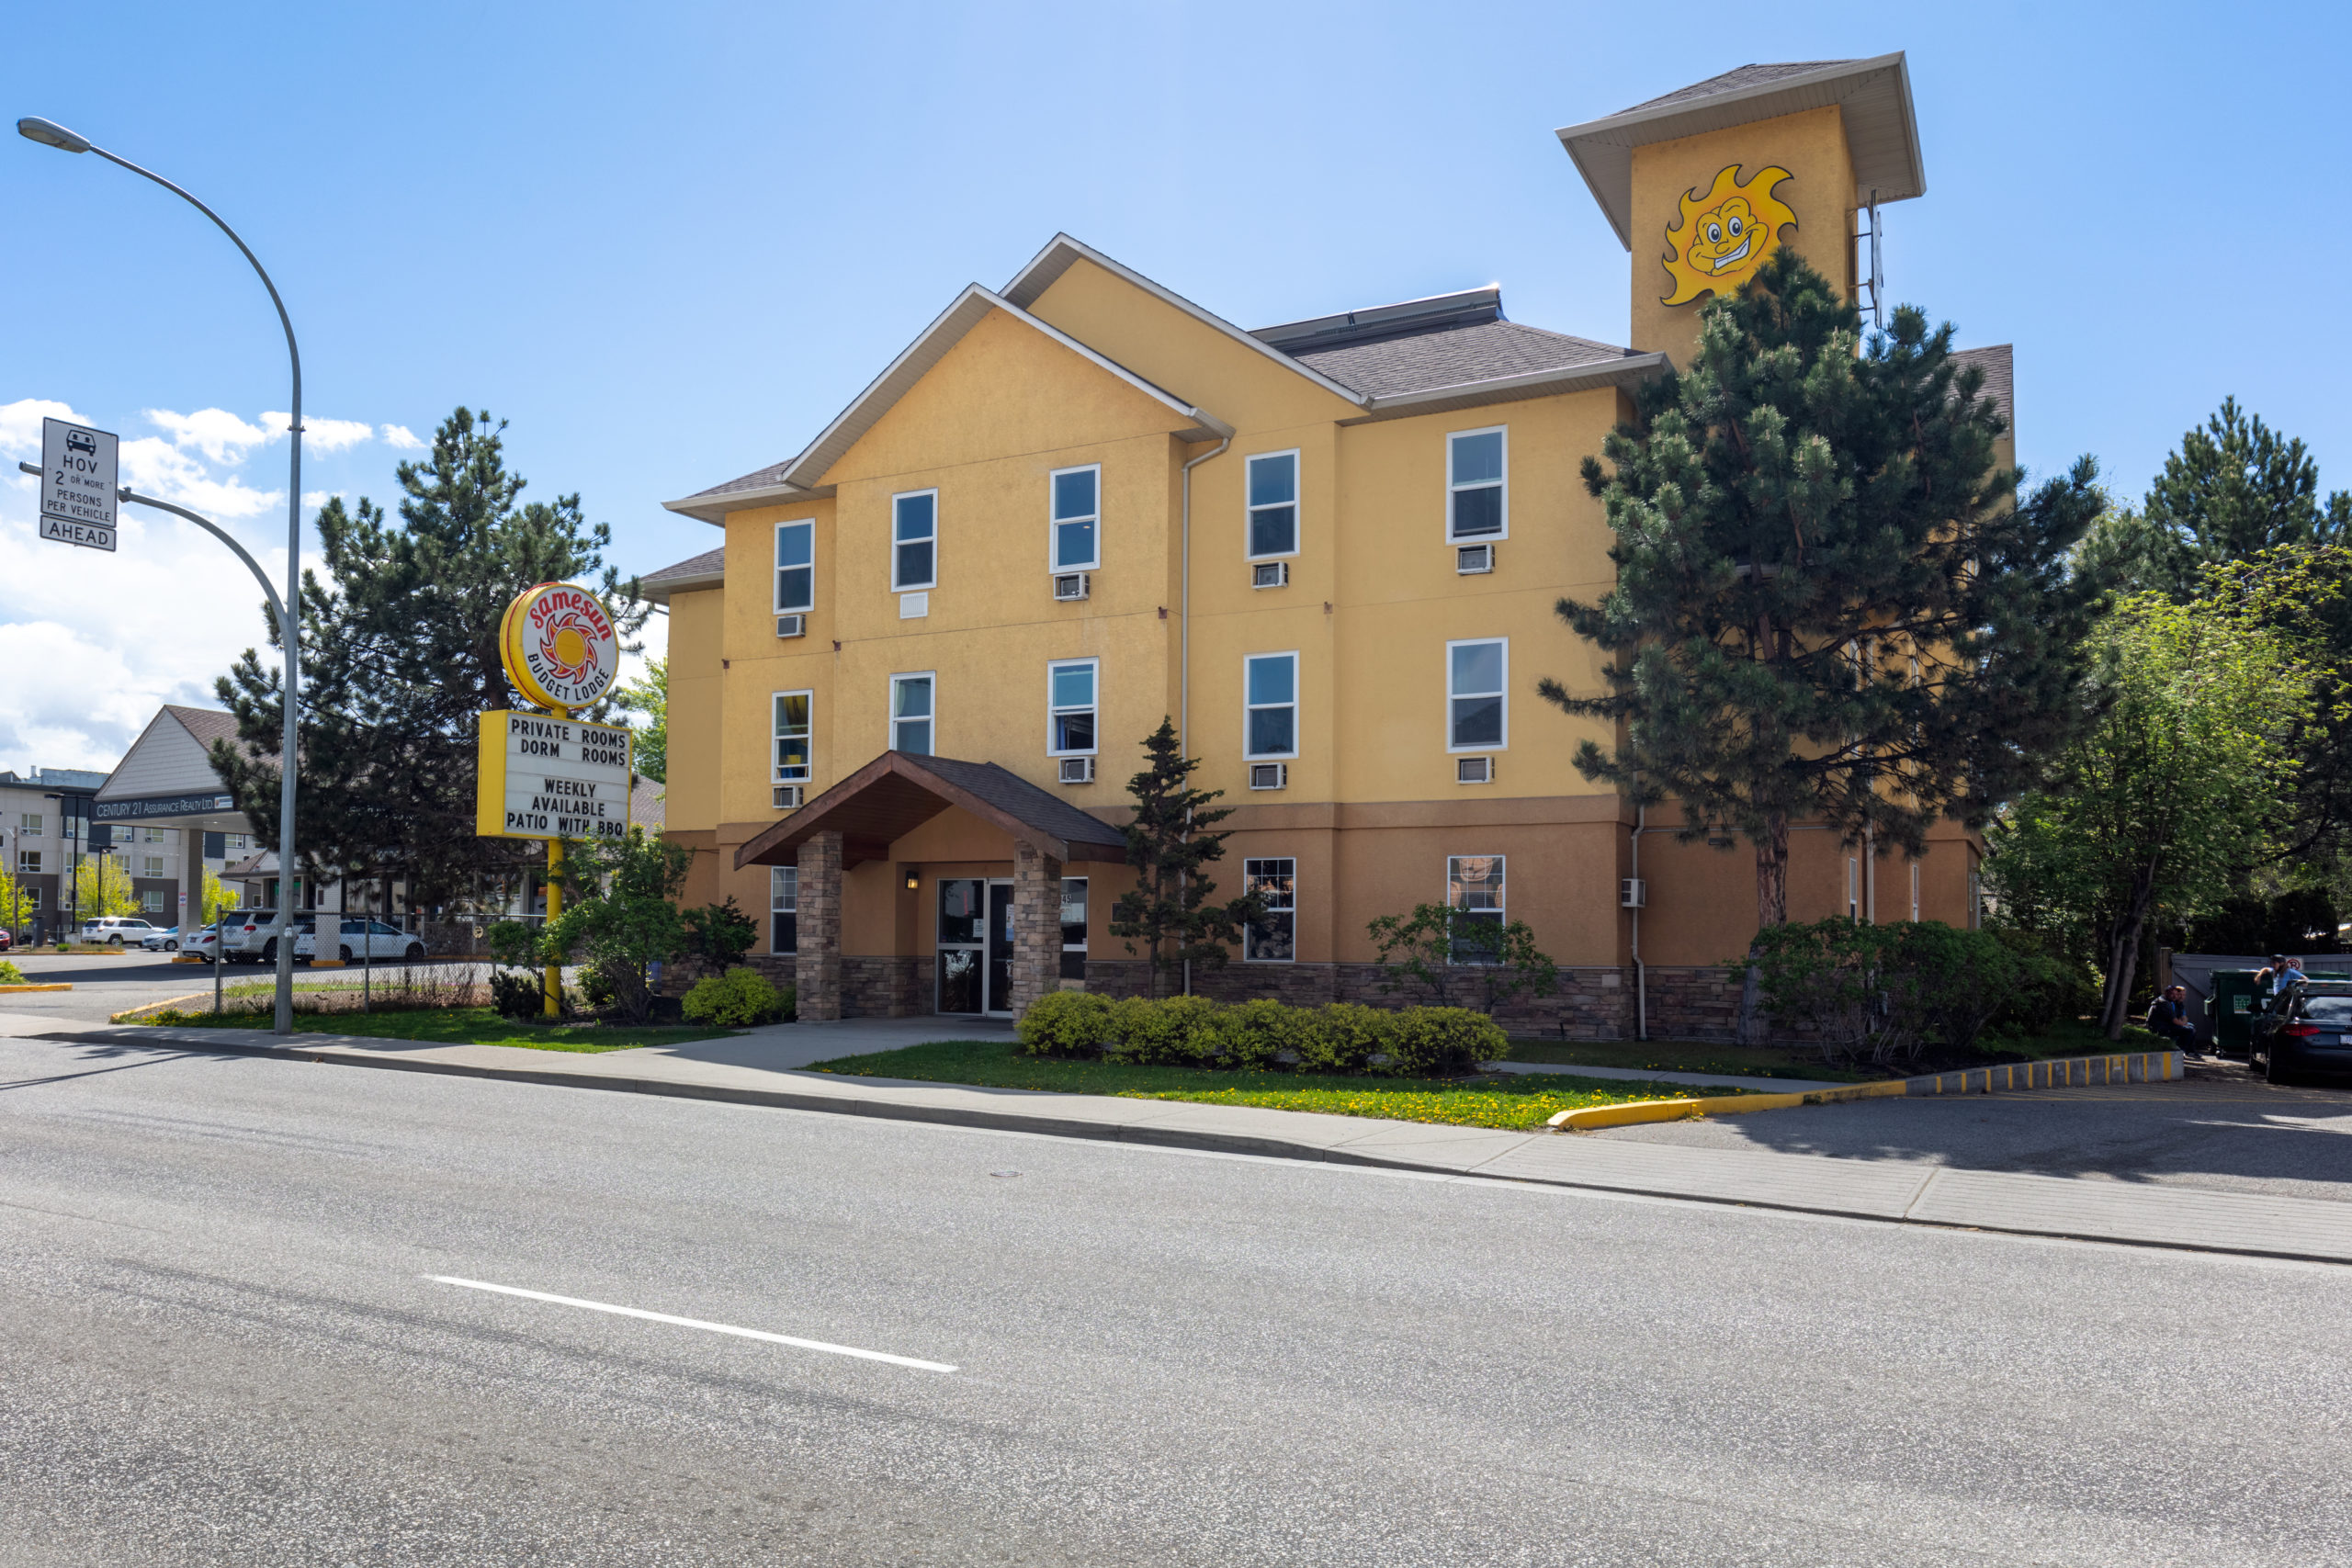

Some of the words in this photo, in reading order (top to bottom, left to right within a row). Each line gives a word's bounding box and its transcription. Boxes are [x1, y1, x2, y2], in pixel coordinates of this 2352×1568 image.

[62, 455, 97, 474] HOV
[55, 470, 64, 486] 2
[70, 476, 81, 485] OR
[84, 479, 105, 491] MORE
[57, 489, 102, 507] PERSONS
[47, 499, 66, 513] PER
[71, 504, 111, 522] VEHICLE
[49, 522, 108, 545] AHEAD
[527, 652, 571, 700] BUDGET
[574, 668, 609, 701] LODGE
[511, 718, 570, 740] PRIVATE
[582, 728, 626, 749] ROOMS
[521, 738, 560, 758] DORM
[582, 747, 626, 766] ROOMS
[544, 778, 596, 797] WEEKLY
[96, 802, 130, 817] CENTURY
[132, 801, 141, 815] 21
[531, 795, 605, 817] AVAILABLE
[507, 812, 548, 829] PATIO
[558, 817, 590, 833] WITH
[598, 820, 623, 837] BBQ
